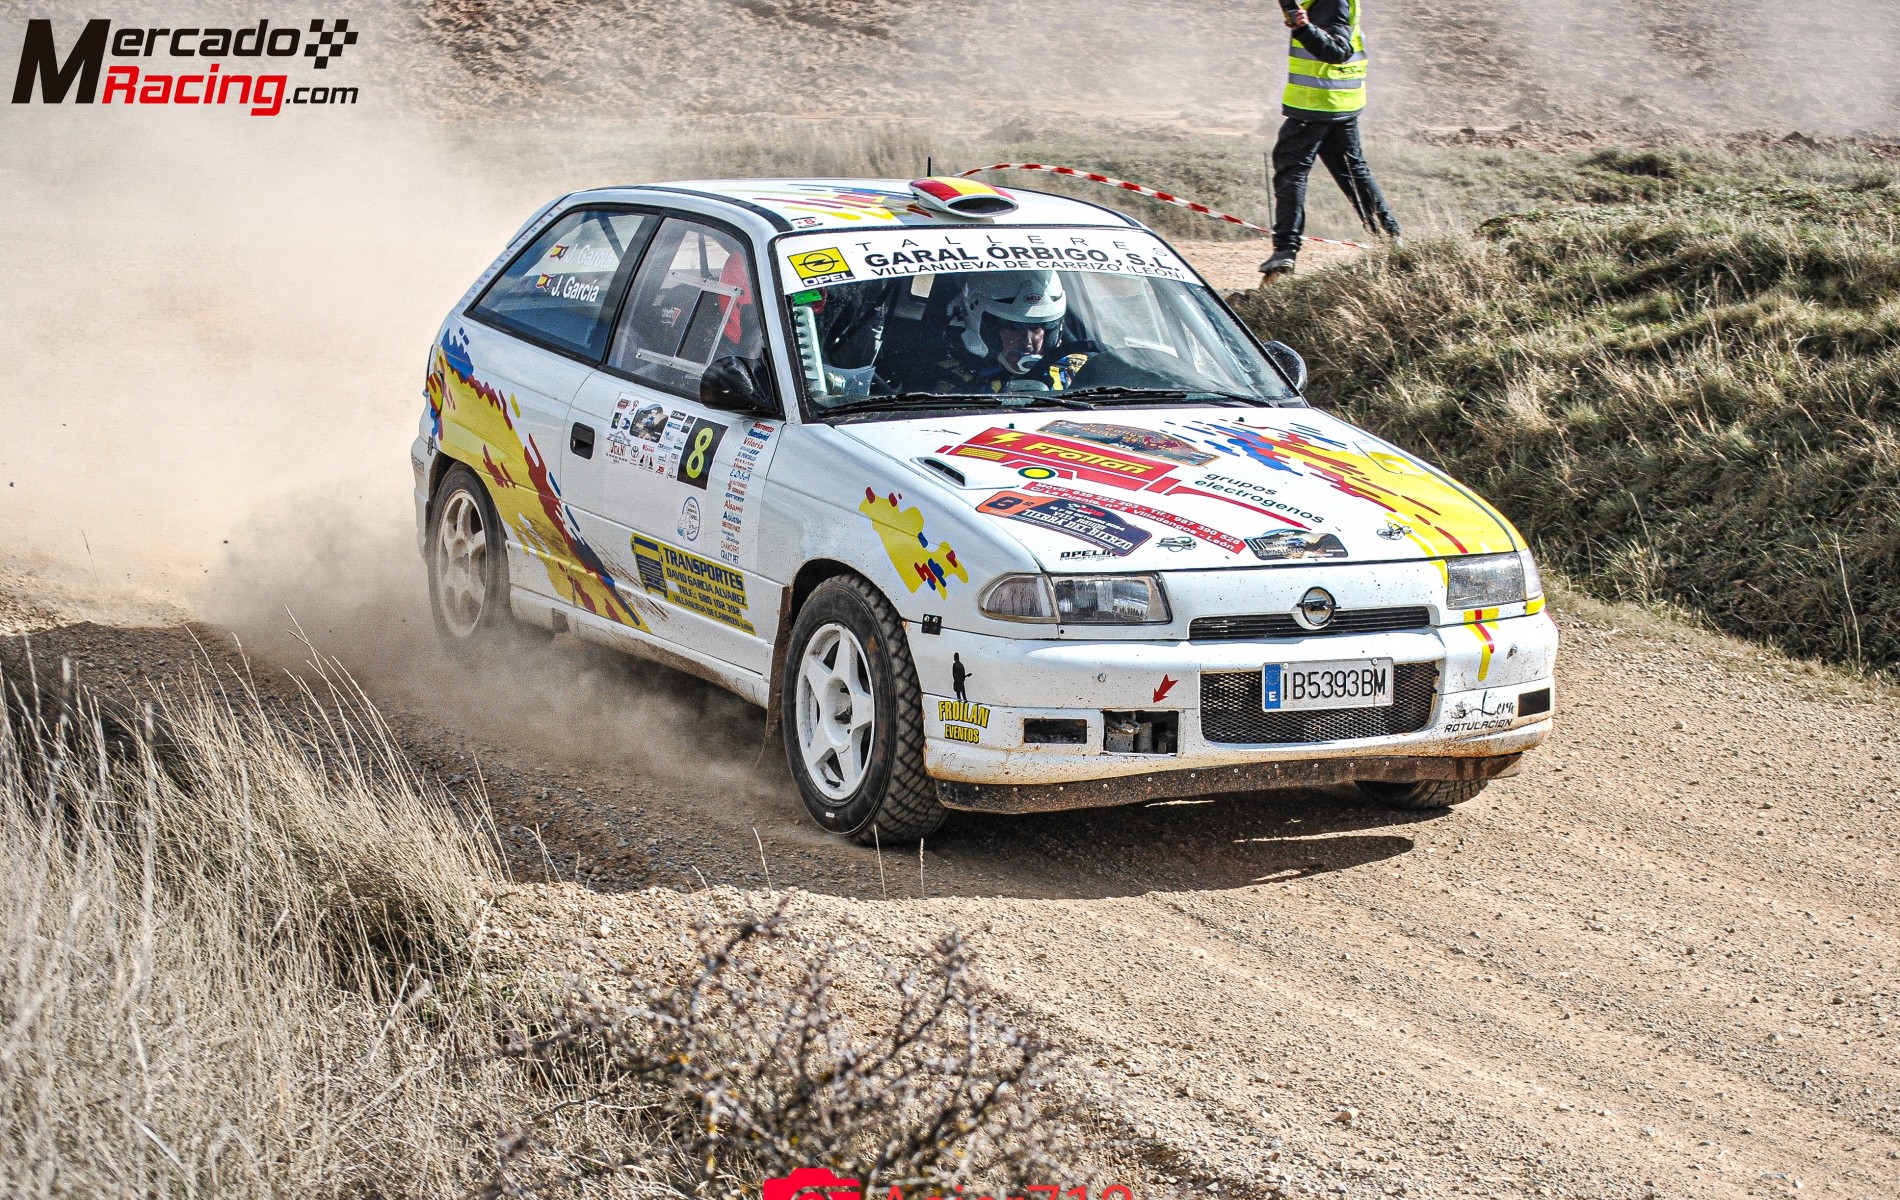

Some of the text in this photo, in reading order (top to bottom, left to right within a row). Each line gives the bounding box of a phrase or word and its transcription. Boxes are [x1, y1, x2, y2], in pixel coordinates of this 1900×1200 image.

[855, 235, 1168, 257] TALLERES
[864, 247, 979, 267] GARAL
[1126, 253, 1180, 271] S.L.
[802, 274, 856, 289] OPEL
[871, 260, 1186, 280] VILLANUEVA DE CARRIZO (LEÓN)
[551, 275, 600, 303] J. García
[686, 427, 714, 479] 8
[1204, 474, 1277, 495] grupos
[1194, 480, 1325, 523] electrogenos
[1021, 508, 1068, 526] TIERRA
[1064, 521, 1091, 533] DEL
[1087, 528, 1133, 550] BIERZO
[1133, 509, 1197, 535] Villadangos
[1206, 535, 1235, 550] León
[1174, 516, 1196, 526] 987
[663, 547, 744, 591] TRANSPORTES
[666, 567, 687, 585] DAVID
[688, 576, 714, 594] GARCIA
[714, 586, 747, 606] ALVAREZ
[1268, 691, 1276, 701] E
[938, 700, 990, 728] FROILAN
[944, 723, 979, 744] EVENTOS
